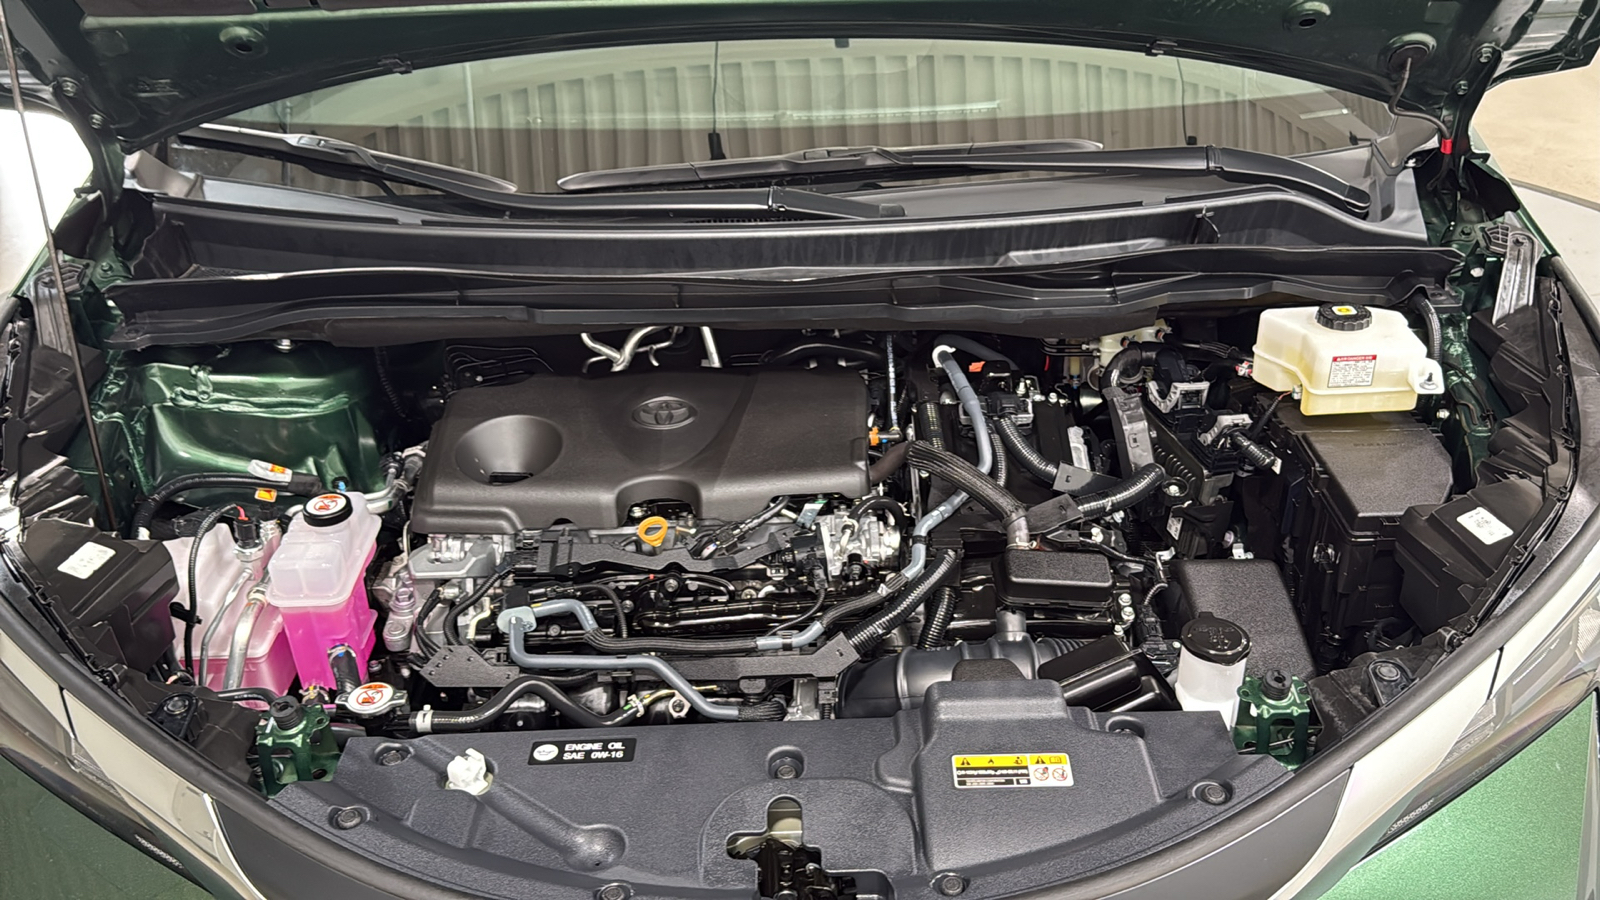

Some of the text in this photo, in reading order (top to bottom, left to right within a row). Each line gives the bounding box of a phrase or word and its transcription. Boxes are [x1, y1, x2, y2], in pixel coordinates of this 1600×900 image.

[564, 742, 625, 751] ENGINE OIL
[562, 751, 624, 760] SAE 0W-16
